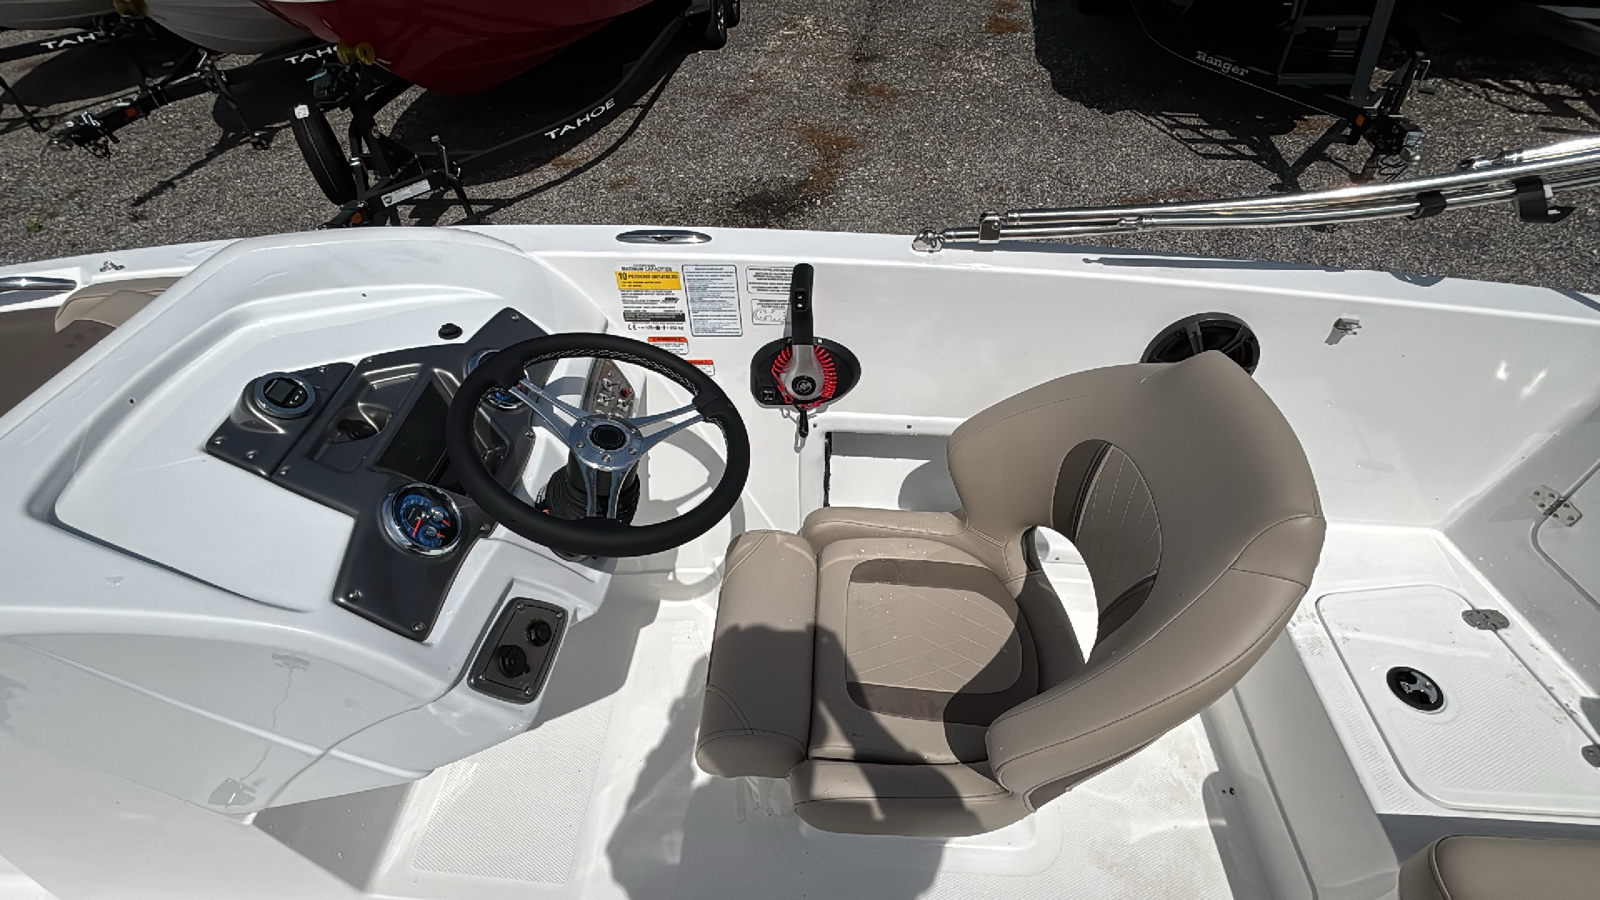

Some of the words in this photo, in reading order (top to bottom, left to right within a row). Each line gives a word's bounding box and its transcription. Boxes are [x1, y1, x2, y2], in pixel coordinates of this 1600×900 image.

[40, 32, 97, 49] TAH
[284, 45, 338, 64] TAH
[1195, 50, 1249, 76] Ranger
[544, 97, 616, 139] TAHOE
[618, 272, 628, 281] 10
